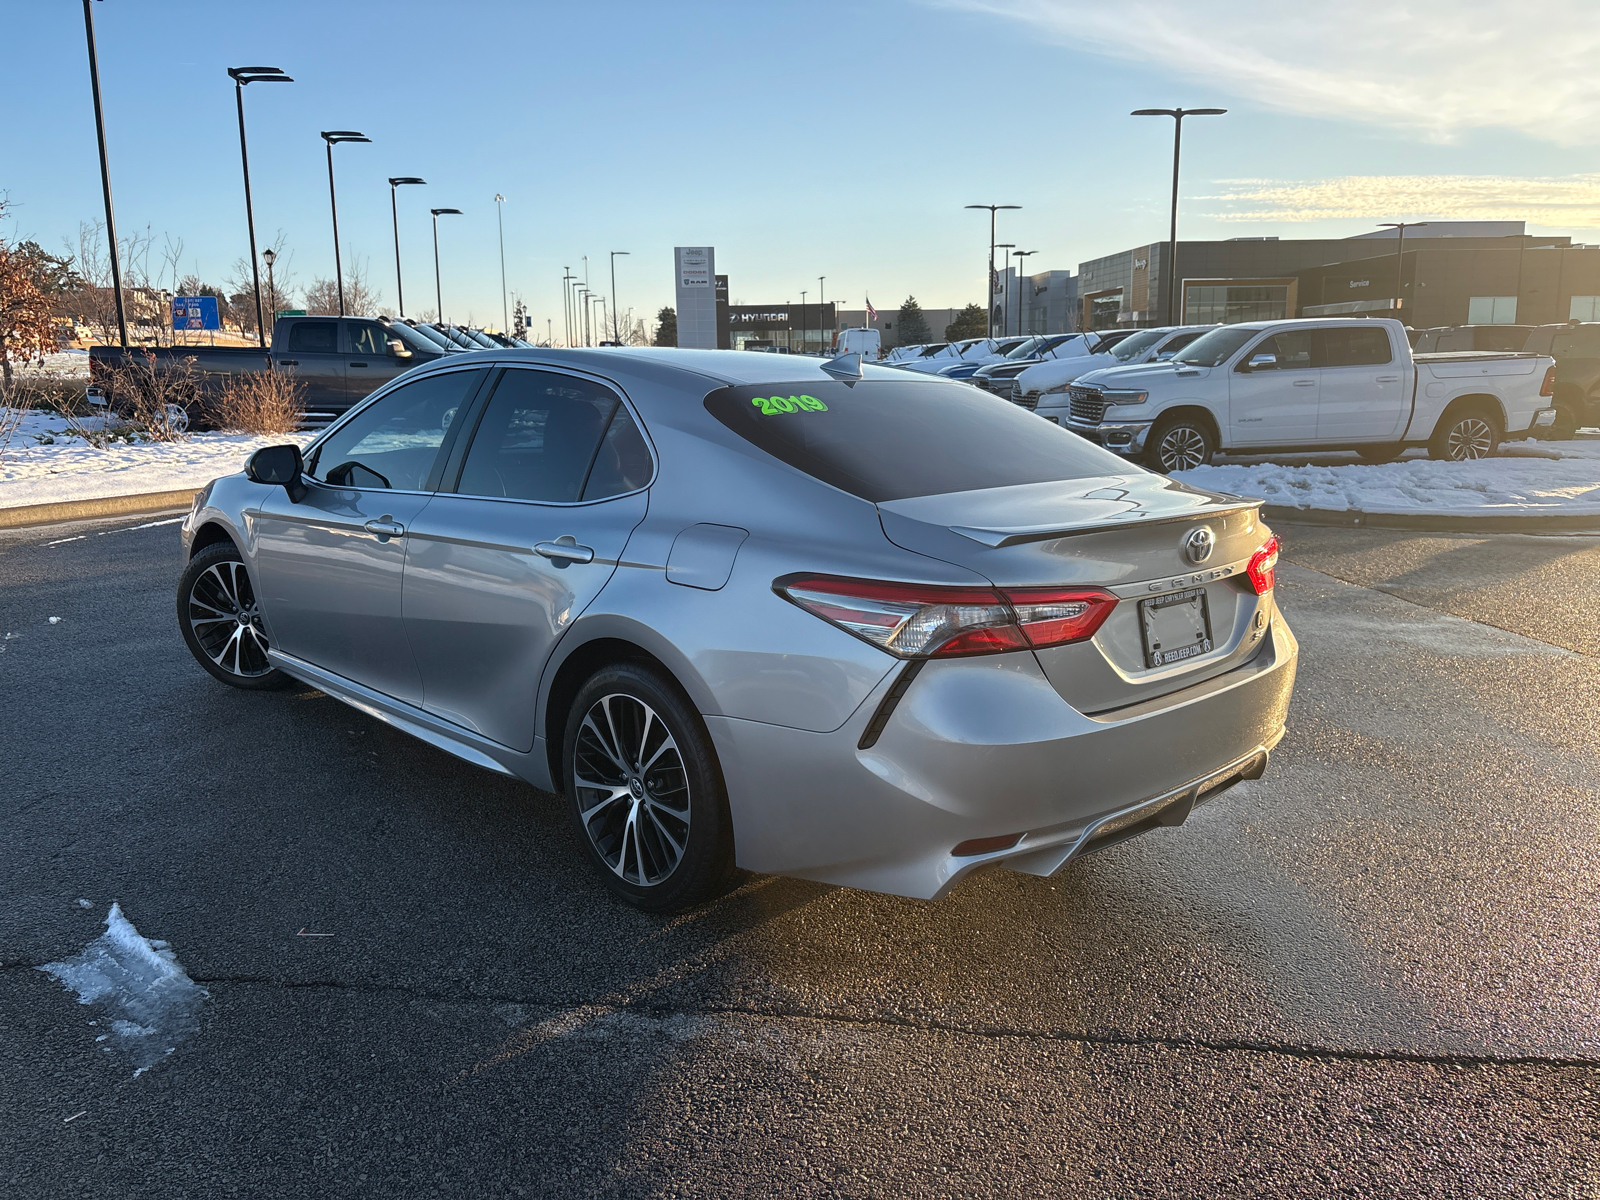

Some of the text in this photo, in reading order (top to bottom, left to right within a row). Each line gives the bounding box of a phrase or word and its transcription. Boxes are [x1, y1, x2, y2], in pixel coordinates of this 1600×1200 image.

[1349, 279, 1370, 288] Service
[741, 312, 788, 322] HYUNDAI
[751, 394, 829, 416] 2019
[1144, 598, 1155, 607] REED
[1155, 596, 1164, 605] JEEP
[1164, 592, 1183, 603] CHRYSLER
[1183, 589, 1196, 599] DODGE
[1164, 644, 1202, 663] REEDJEEP.COM
